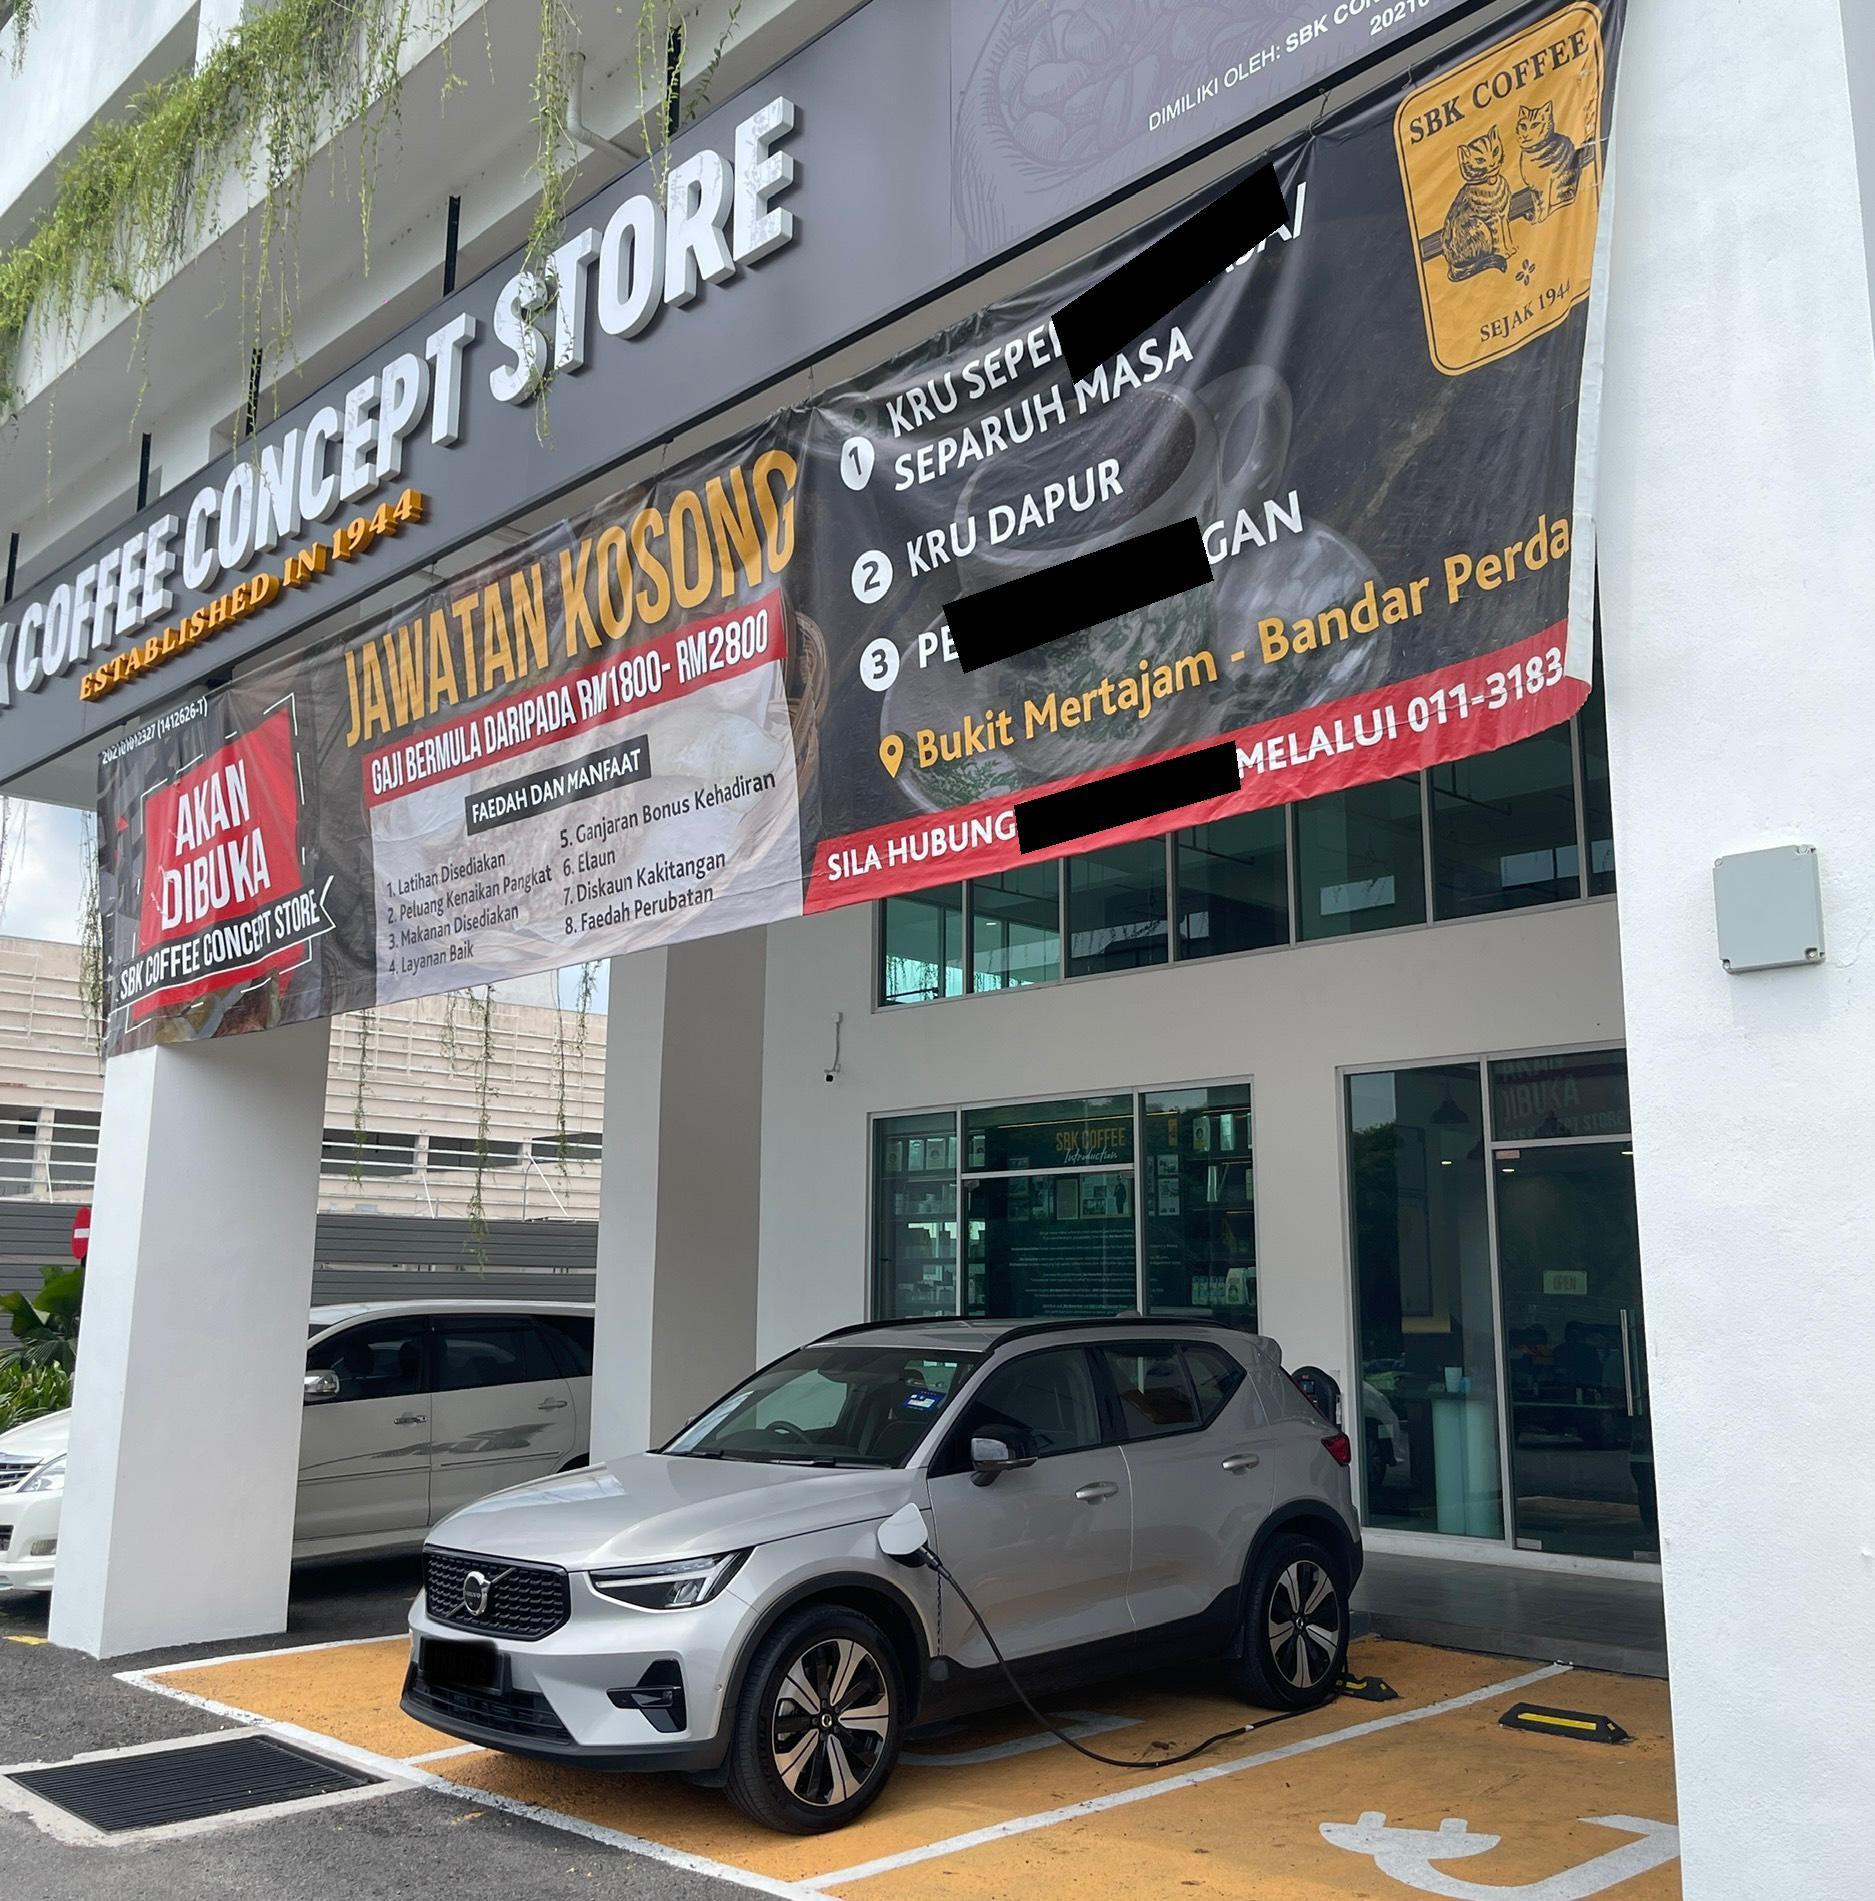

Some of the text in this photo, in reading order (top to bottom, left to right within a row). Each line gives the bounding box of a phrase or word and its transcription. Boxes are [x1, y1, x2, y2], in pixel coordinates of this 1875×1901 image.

[1149, 78, 1219, 131] DIMILIKI
[1223, 45, 1281, 88] OLEH:
[1286, 14, 1328, 52] SBK
[1409, 28, 1589, 144] SBK COFFEE
[1480, 300, 1534, 342] SEJAK
[15, 96, 794, 693] COFFEE CONCEPT STORE
[886, 320, 1063, 438] KRU SEPE
[893, 326, 1194, 492] SEPARUH MASA
[906, 516, 977, 578] KRU
[988, 458, 1124, 545] DAPUR
[1202, 490, 1303, 565] GAN
[80, 573, 279, 701] ESTABLISHED
[283, 543, 326, 587] IN
[331, 489, 424, 561] 1944
[344, 449, 799, 747] JAWATAN KOSONG
[917, 513, 1571, 769] Bukit Mertajam - Bandar Perda
[157, 696, 208, 739] (1412626-T)
[371, 610, 768, 795] GAJI BERMULA DARIPADA RM1800- RM2800
[175, 759, 250, 856] AKAN
[471, 748, 641, 824] FAEDAH DAN MANFAAT
[560, 772, 776, 849] 5. Ganjaran Bonus Kehadiran
[827, 847, 882, 882] SILA
[888, 810, 1016, 867] HUBUNG
[1237, 705, 1398, 780] MELALUI
[161, 827, 271, 931] DIBUKA
[387, 851, 506, 898] 1. Latihan Disediakan
[388, 864, 552, 925] 2. Peluang Kenaikan Pangkat
[563, 849, 616, 877] 6. Elaun
[563, 851, 726, 906] 7. Diskaun Kakitangan
[565, 883, 714, 935] 8. Faedah Perubatan
[120, 888, 320, 1000] SBK COFFEE CONCEPT STORE
[388, 904, 519, 950] 3. Makanan Disediakan
[388, 942, 474, 976] 4. Layanan Baik
[1056, 1127, 1125, 1151] SBK COFFEE
